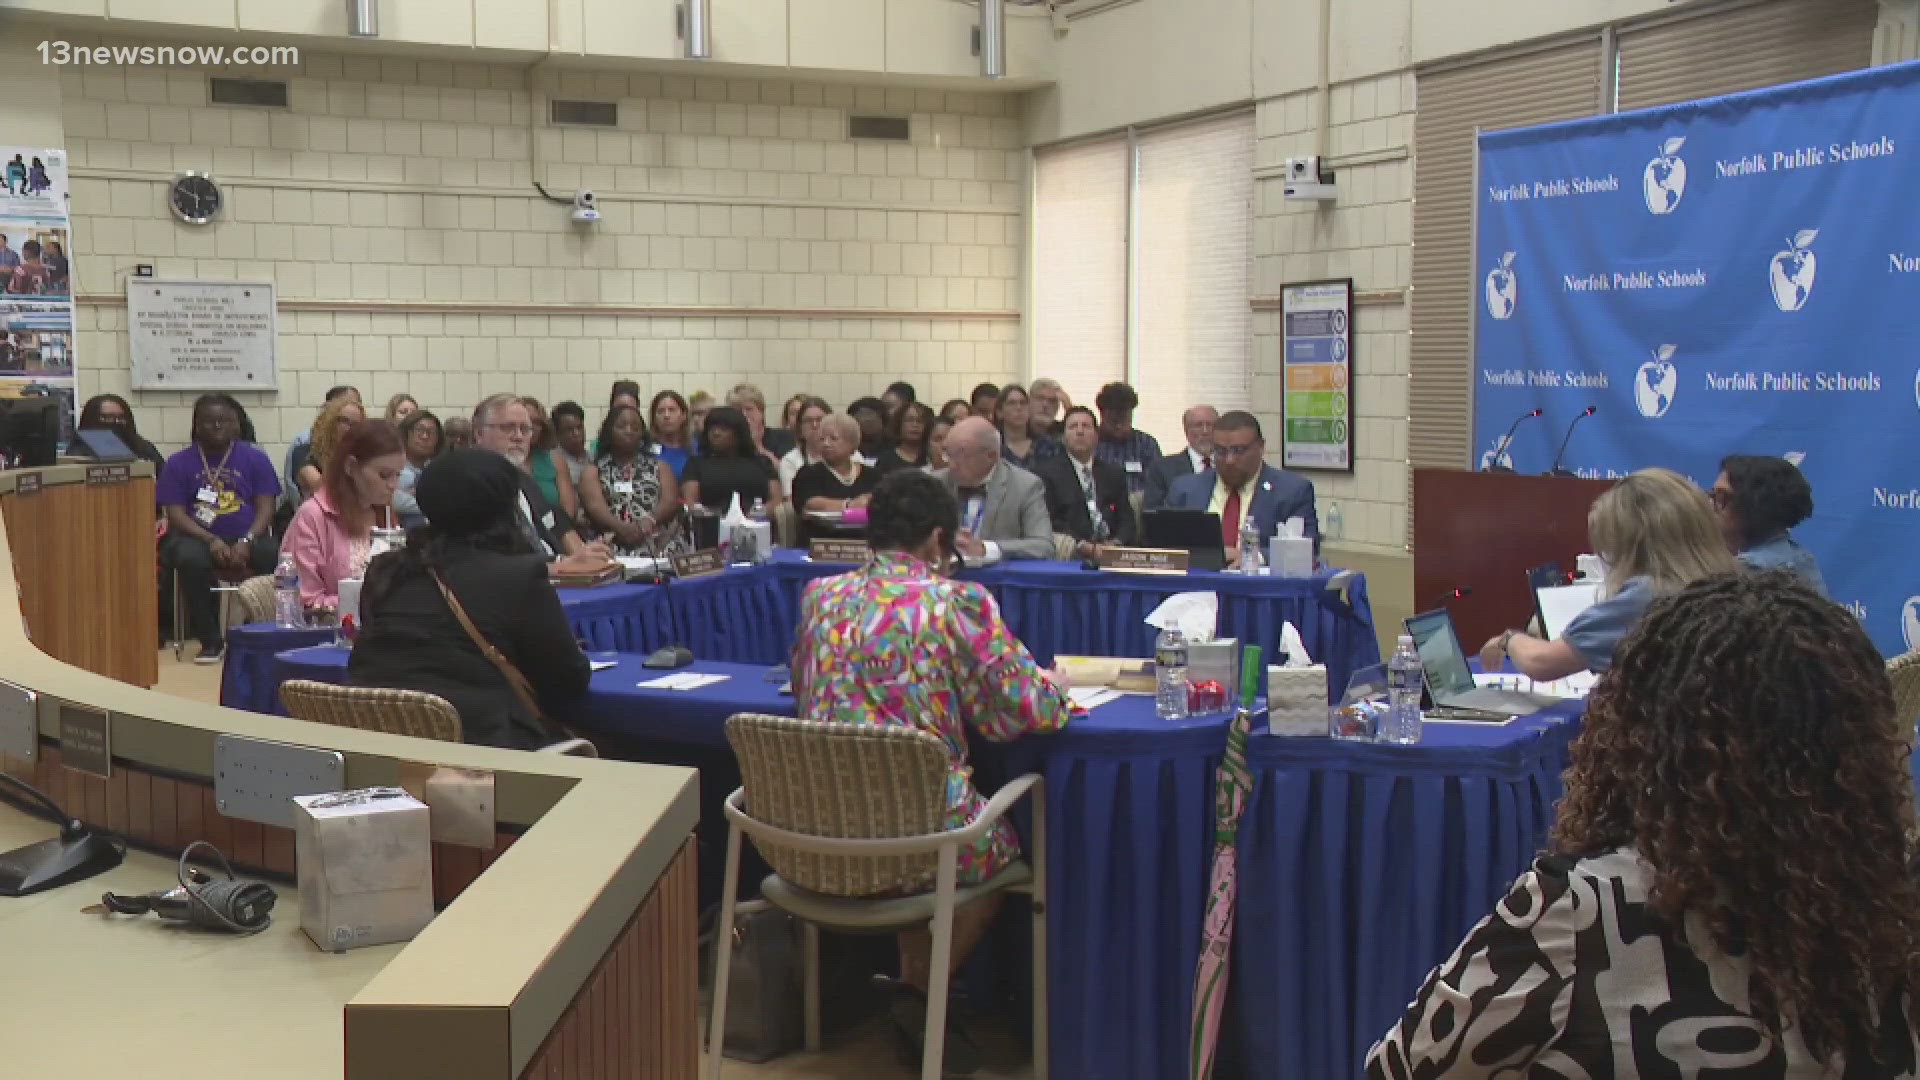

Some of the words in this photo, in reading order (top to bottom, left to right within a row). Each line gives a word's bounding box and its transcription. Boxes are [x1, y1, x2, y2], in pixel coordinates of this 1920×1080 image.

[1716, 153, 1767, 179] Norfolk
[1773, 146, 1825, 171] Public
[1829, 135, 1895, 163] Schools
[1489, 183, 1530, 202] Norfolk
[1533, 179, 1571, 199] Public
[1571, 173, 1619, 195] Schools
[1563, 272, 1610, 291] Norfolk
[1614, 271, 1655, 289] Public
[1657, 267, 1706, 288] Schools
[1483, 369, 1525, 385] Norfolk
[1527, 369, 1561, 387] Public
[1563, 370, 1609, 388] Schools
[1705, 371, 1759, 391] Norfolk
[1762, 371, 1811, 391] Public
[1815, 371, 1881, 392] Schools
